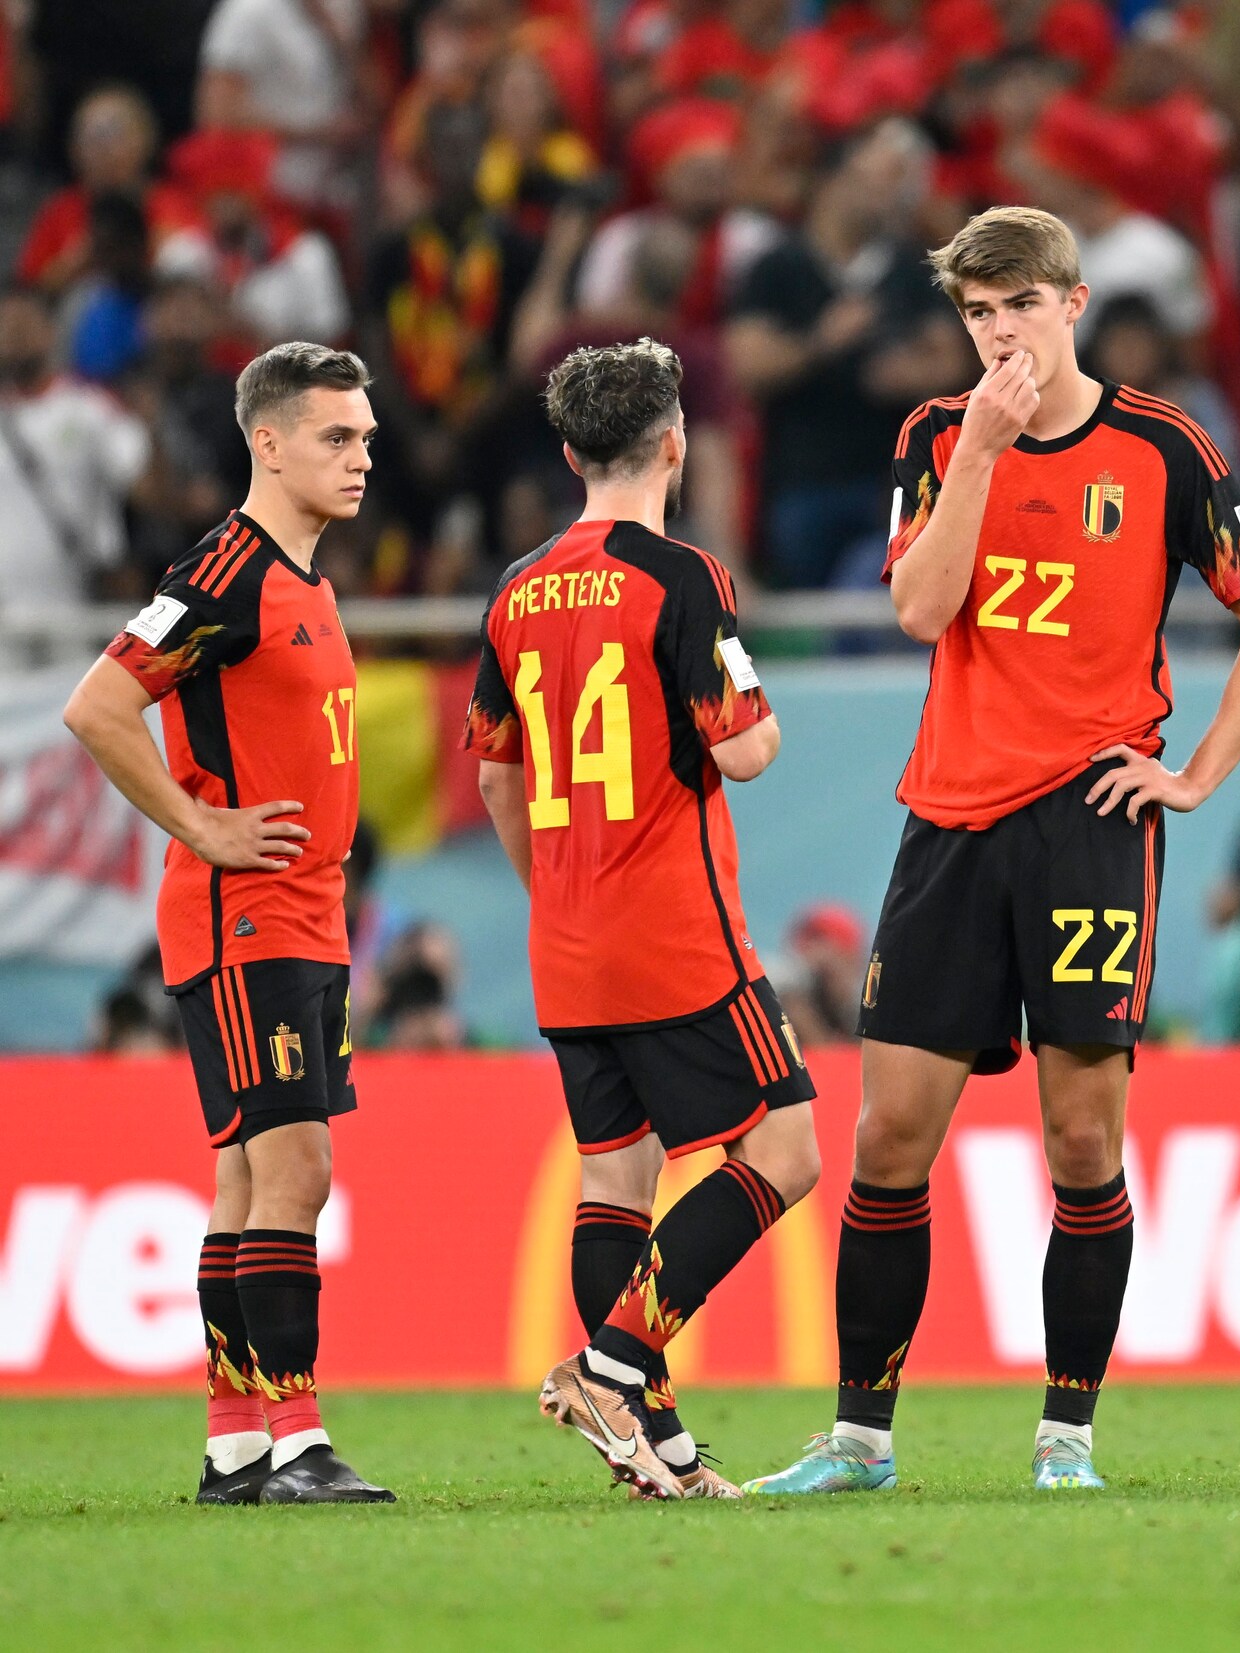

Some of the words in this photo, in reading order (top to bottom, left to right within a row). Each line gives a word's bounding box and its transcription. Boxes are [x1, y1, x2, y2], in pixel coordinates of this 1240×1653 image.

[508, 570, 625, 621] MERTENS
[977, 555, 1076, 637] 22
[321, 687, 354, 765] 17
[514, 642, 634, 830] 14
[1052, 909, 1137, 985] 22
